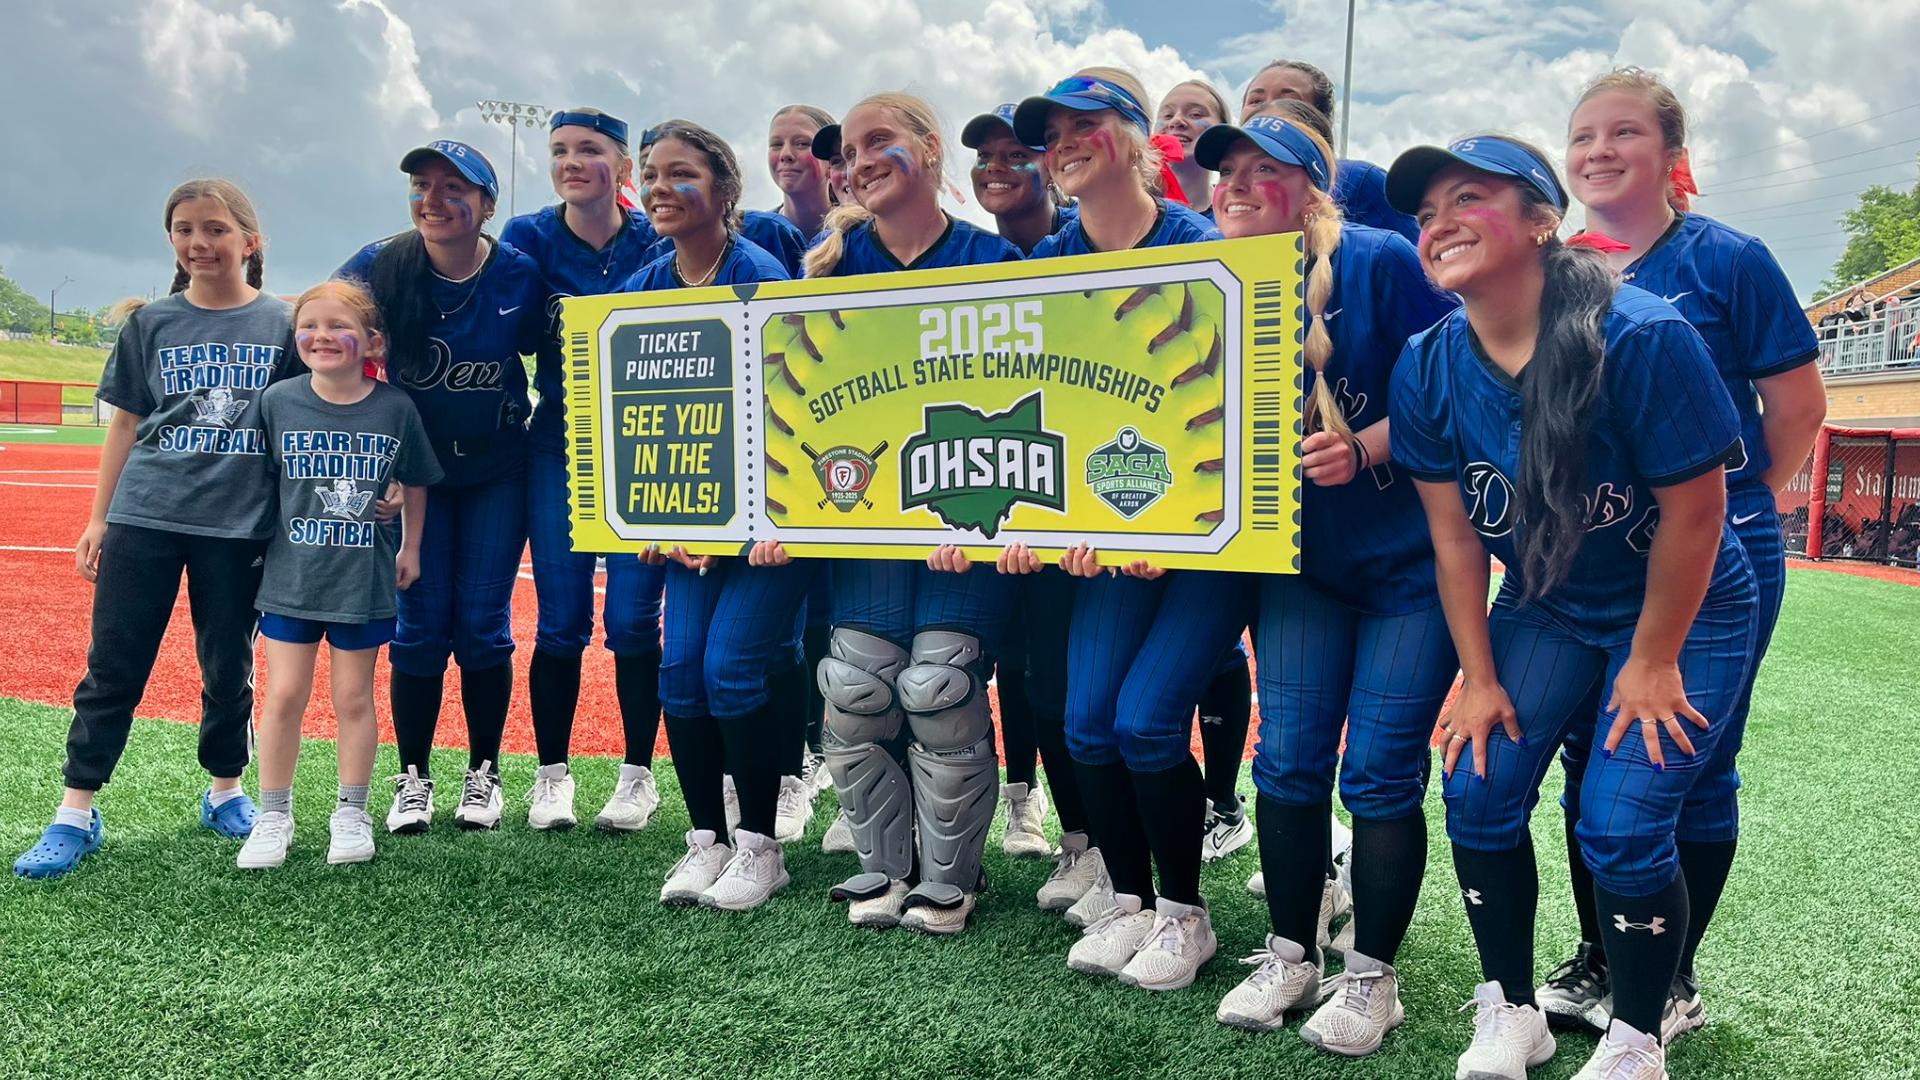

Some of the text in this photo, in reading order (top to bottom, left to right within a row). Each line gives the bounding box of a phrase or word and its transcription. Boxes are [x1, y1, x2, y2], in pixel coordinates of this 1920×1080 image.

[1246, 117, 1284, 132] EVS
[638, 331, 702, 355] TICKET
[919, 300, 1043, 361] 2025
[159, 342, 229, 371] FEAR
[626, 356, 715, 381] PUNCHED!
[161, 363, 272, 396] TRADITIO
[808, 351, 1166, 424] SOFTBALL STATE CHAMPIONSHIPS
[622, 402, 723, 437] SEE YOU
[282, 431, 400, 461] FEAR THE
[633, 442, 713, 475] IN THE
[817, 448, 873, 466] FIRESTONE STADIUM
[910, 436, 1055, 498] OHSAA
[1088, 453, 1171, 483] SAGA
[1855, 464, 1920, 499] Staium
[628, 482, 720, 514] FINALS!
[1096, 478, 1162, 492] SPORTS ALLIANCE
[289, 517, 374, 548] SOFTBA
